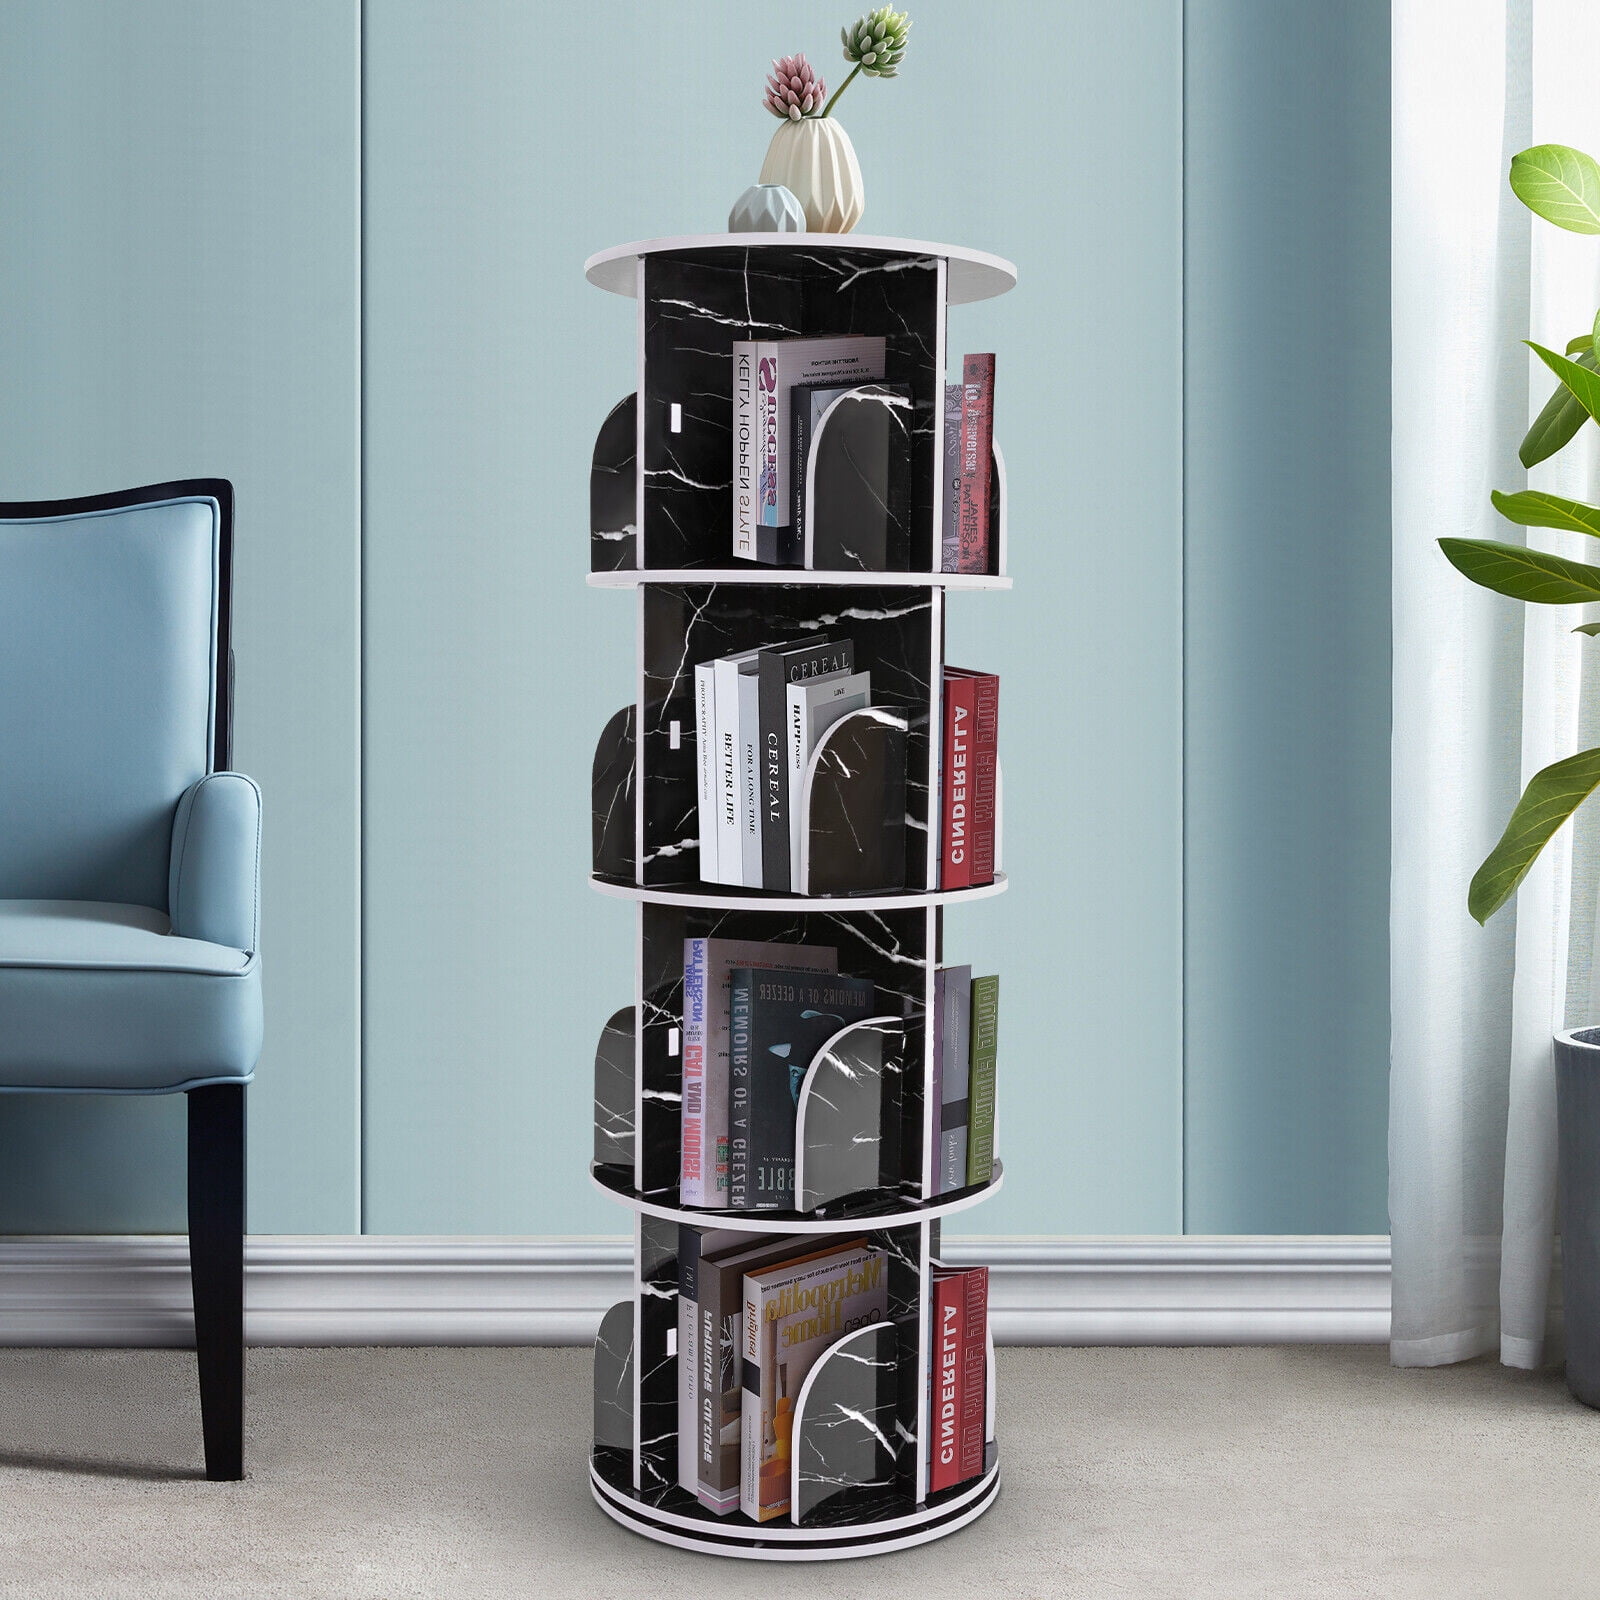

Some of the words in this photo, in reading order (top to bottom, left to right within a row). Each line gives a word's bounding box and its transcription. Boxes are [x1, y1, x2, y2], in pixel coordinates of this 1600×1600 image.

[962, 483, 971, 560] PATTERSON
[970, 500, 979, 543] JAMES
[790, 652, 849, 682] CEREAL
[724, 732, 734, 789] BETTER
[793, 704, 801, 770] HAPPINESS
[767, 732, 780, 823] CEREAL
[725, 792, 734, 825] LIFE
